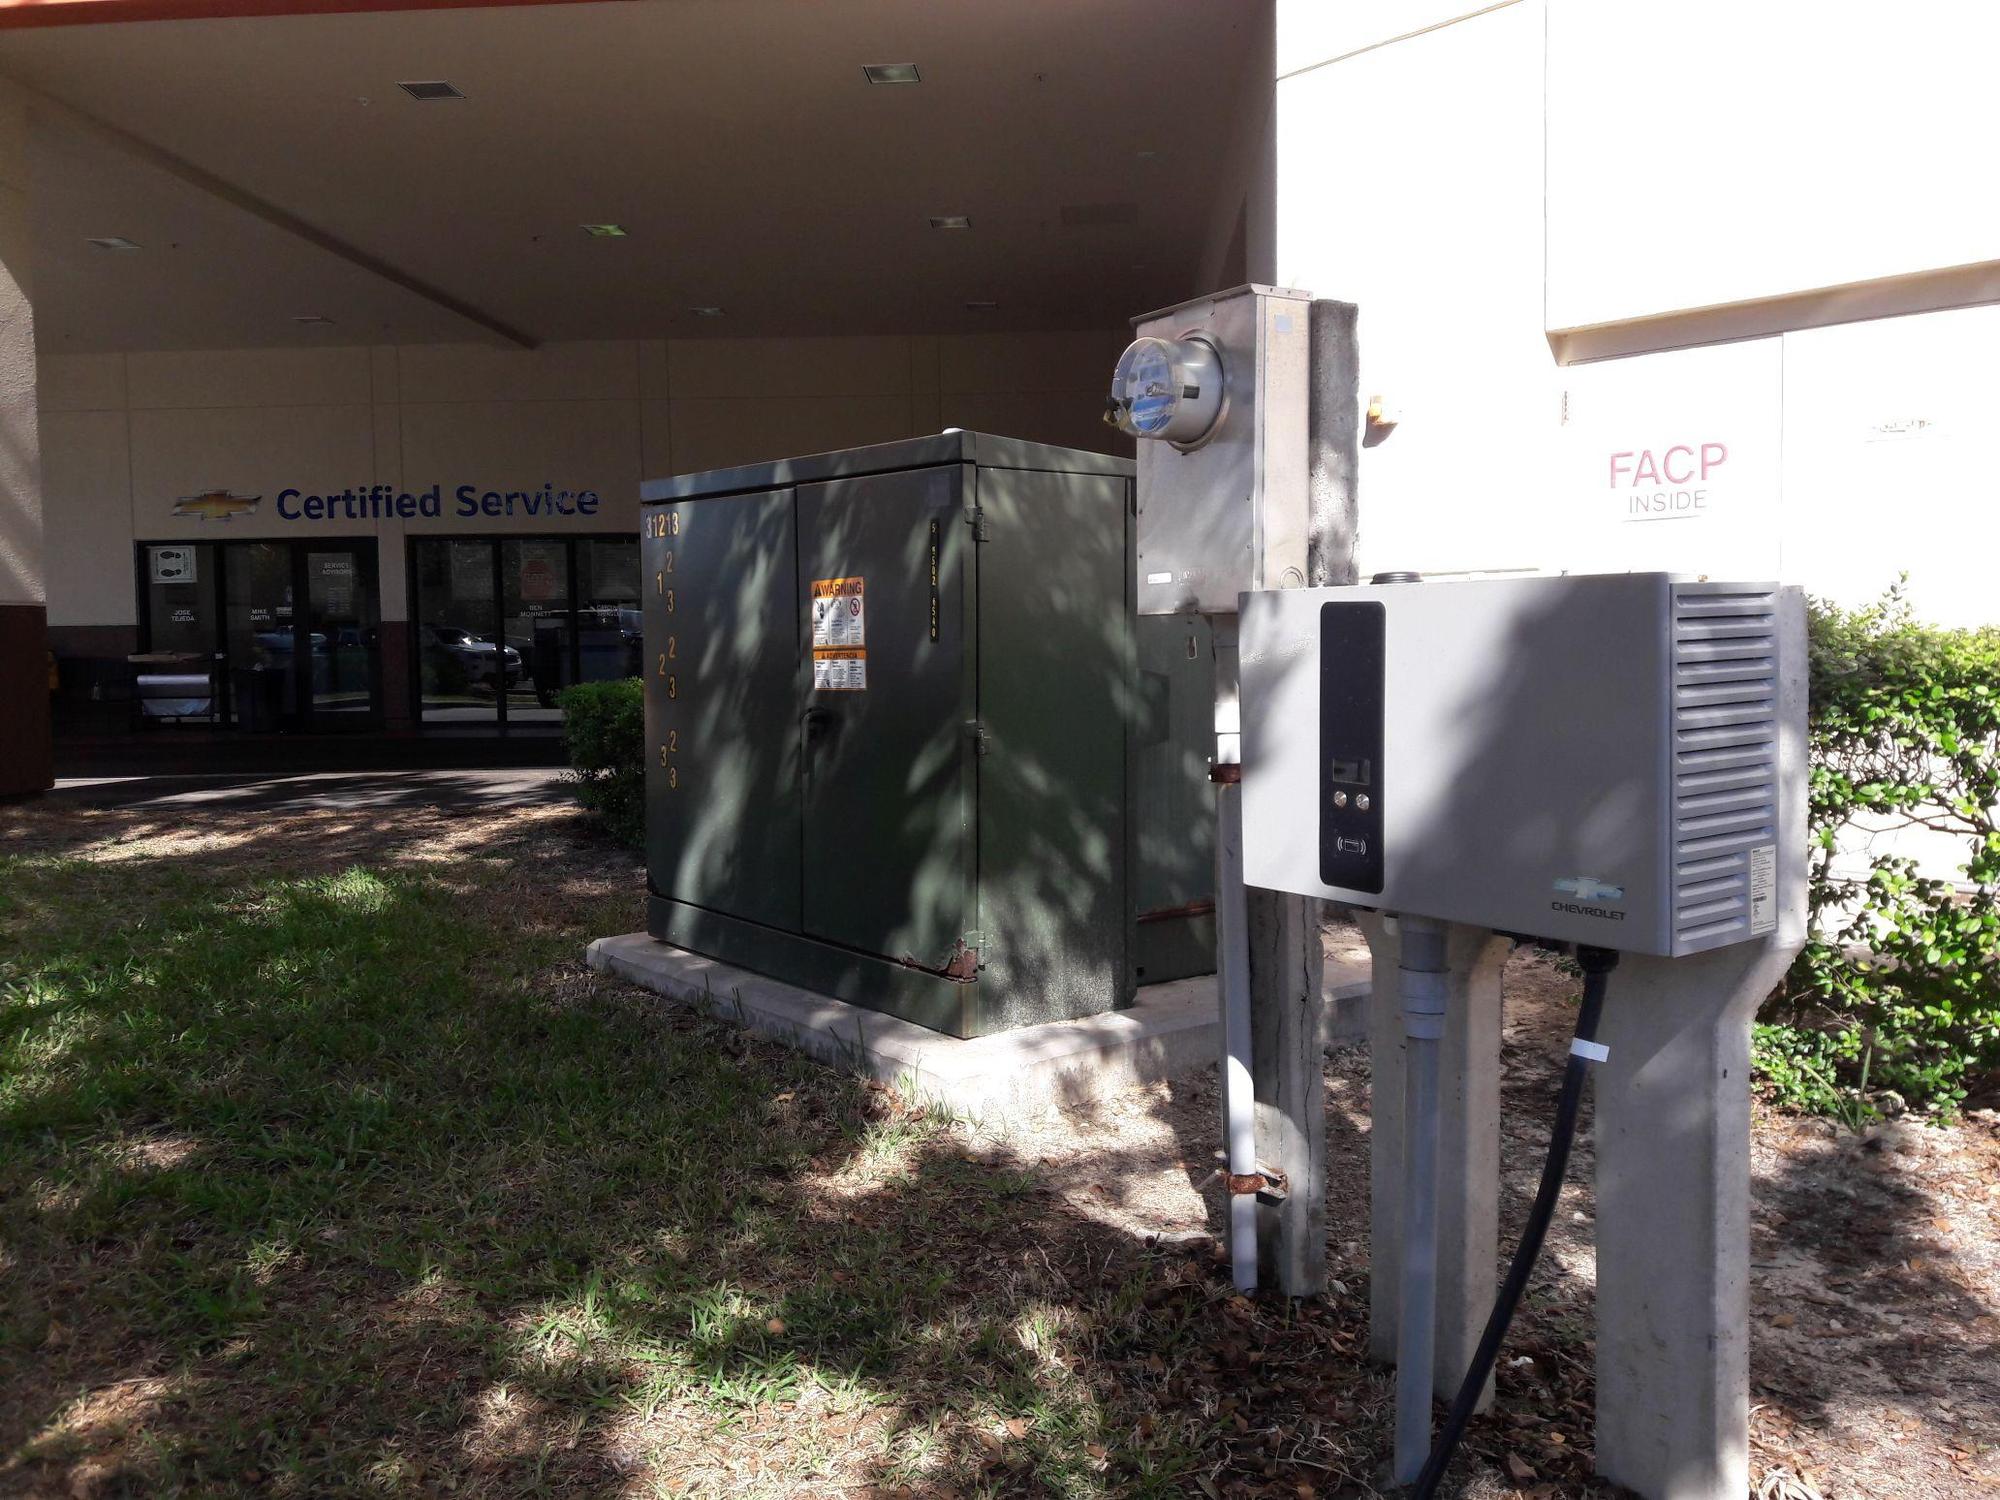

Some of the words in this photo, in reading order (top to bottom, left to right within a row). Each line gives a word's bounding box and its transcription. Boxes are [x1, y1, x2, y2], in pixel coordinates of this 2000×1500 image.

[1610, 443, 1728, 489] FACP
[277, 485, 441, 519] Certified
[456, 483, 599, 516] Service
[1629, 489, 1707, 514] INSIDE
[646, 512, 679, 539] 31213
[820, 581, 862, 597] WARNING
[1551, 902, 1627, 921] CHEVROLET
